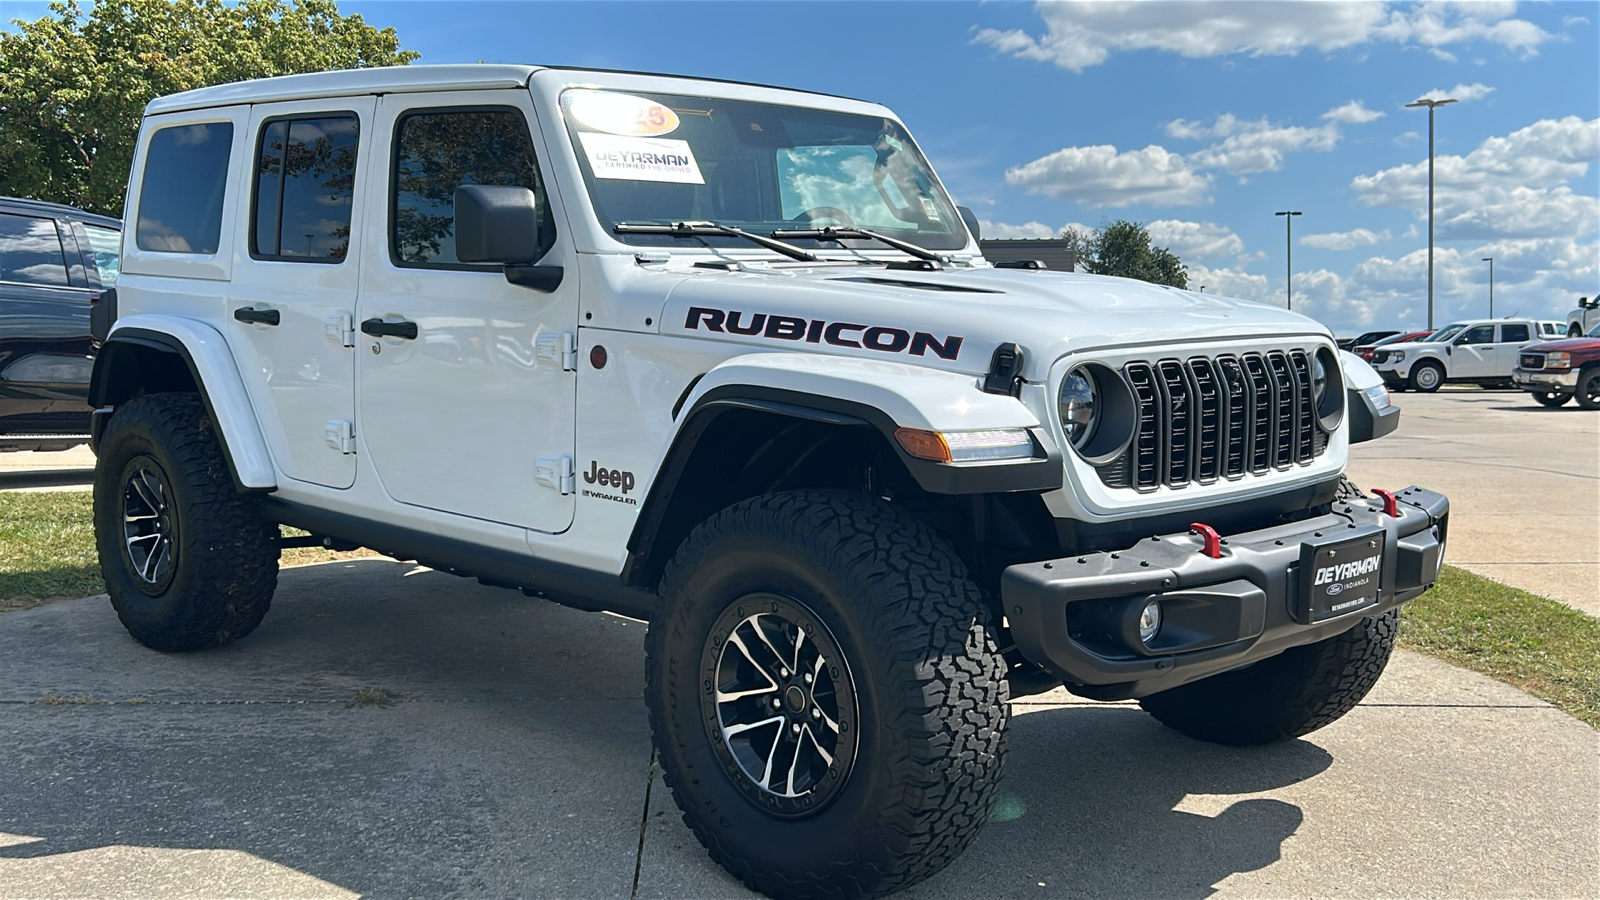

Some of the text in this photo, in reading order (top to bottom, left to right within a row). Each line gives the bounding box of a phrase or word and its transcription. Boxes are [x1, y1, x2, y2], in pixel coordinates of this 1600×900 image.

[596, 150, 689, 167] DEYARMAN
[605, 161, 692, 174] CERTIFIED PRE-OWNED
[684, 306, 965, 361] RUBICON
[583, 460, 635, 494] Jeep
[590, 491, 637, 505] WRANGLER
[1314, 554, 1380, 586] DEYARMAN
[1343, 577, 1369, 590] INDIANOLA
